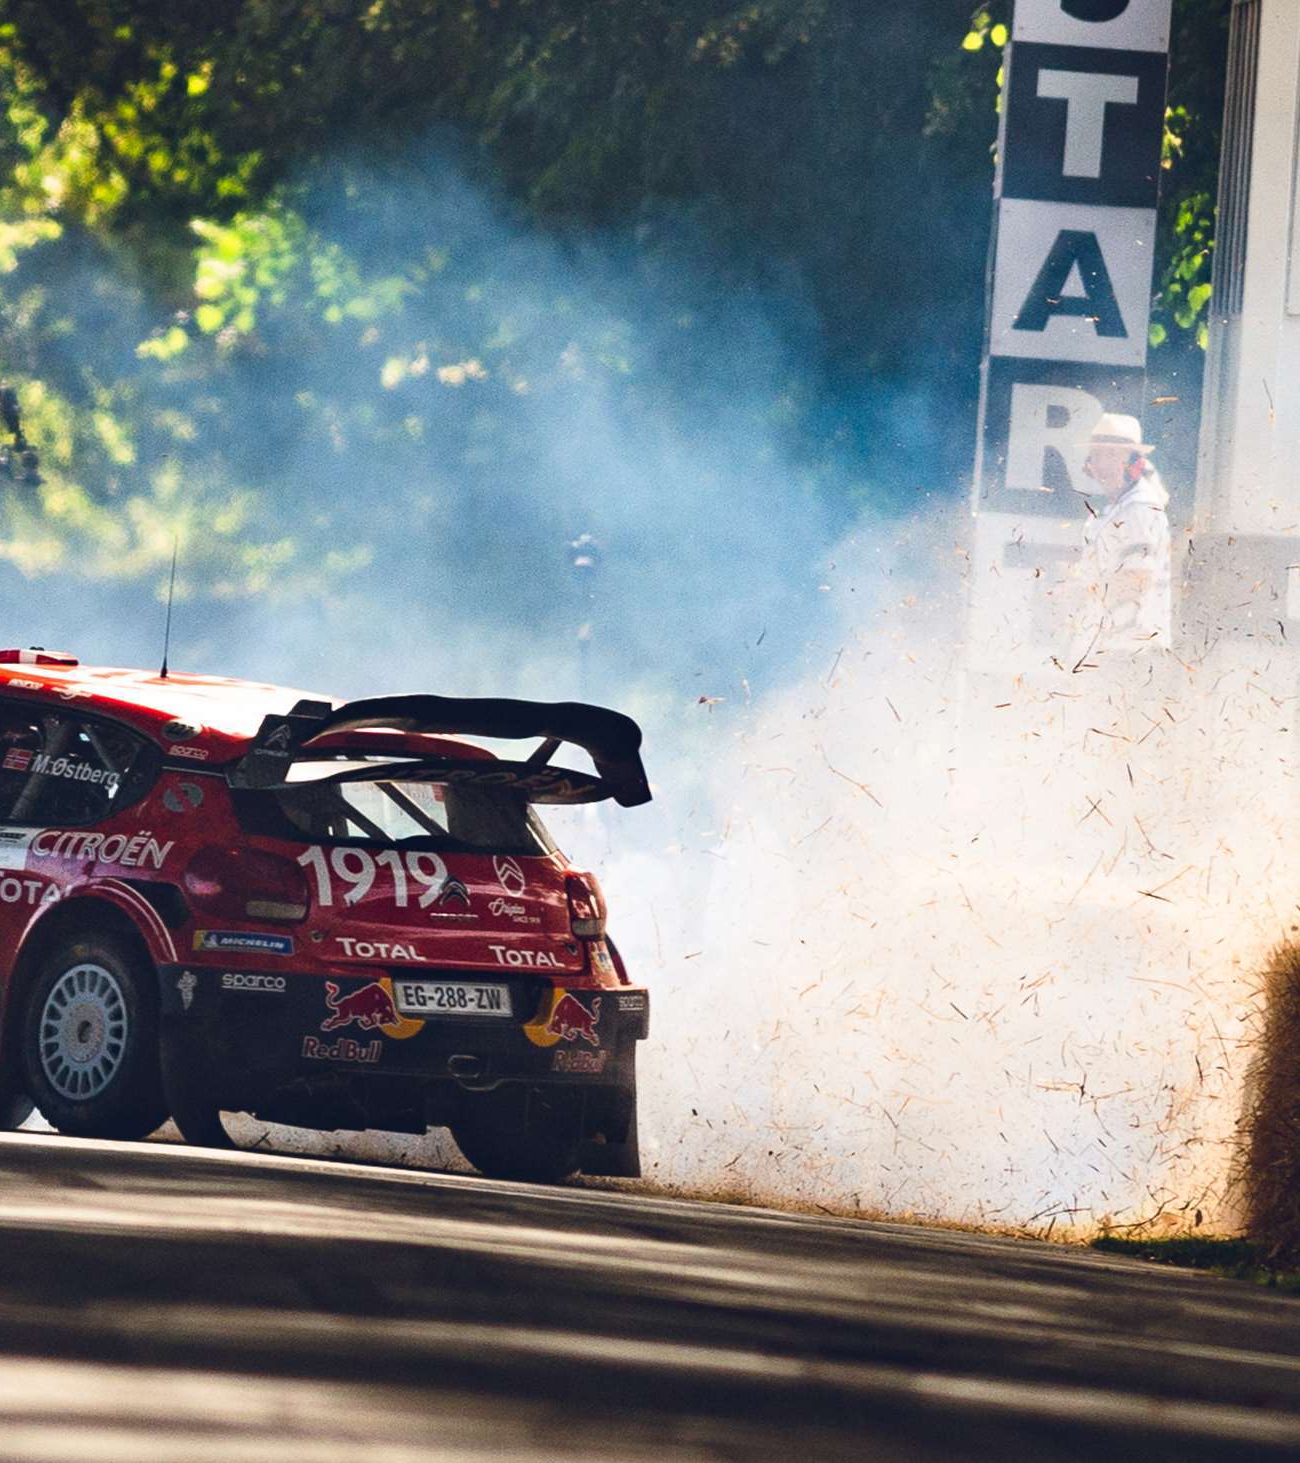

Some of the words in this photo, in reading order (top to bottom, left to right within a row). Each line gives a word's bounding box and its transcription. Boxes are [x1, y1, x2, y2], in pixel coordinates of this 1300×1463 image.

[1003, 0, 1140, 650] TART
[31, 830, 175, 869] CITROËN
[296, 845, 449, 909] 1919
[220, 936, 285, 949] MICHELIN
[335, 937, 427, 961] TOTAL
[488, 945, 566, 968] TOTAL
[221, 971, 286, 990] sparco
[402, 985, 501, 1010] EG-288-ZW
